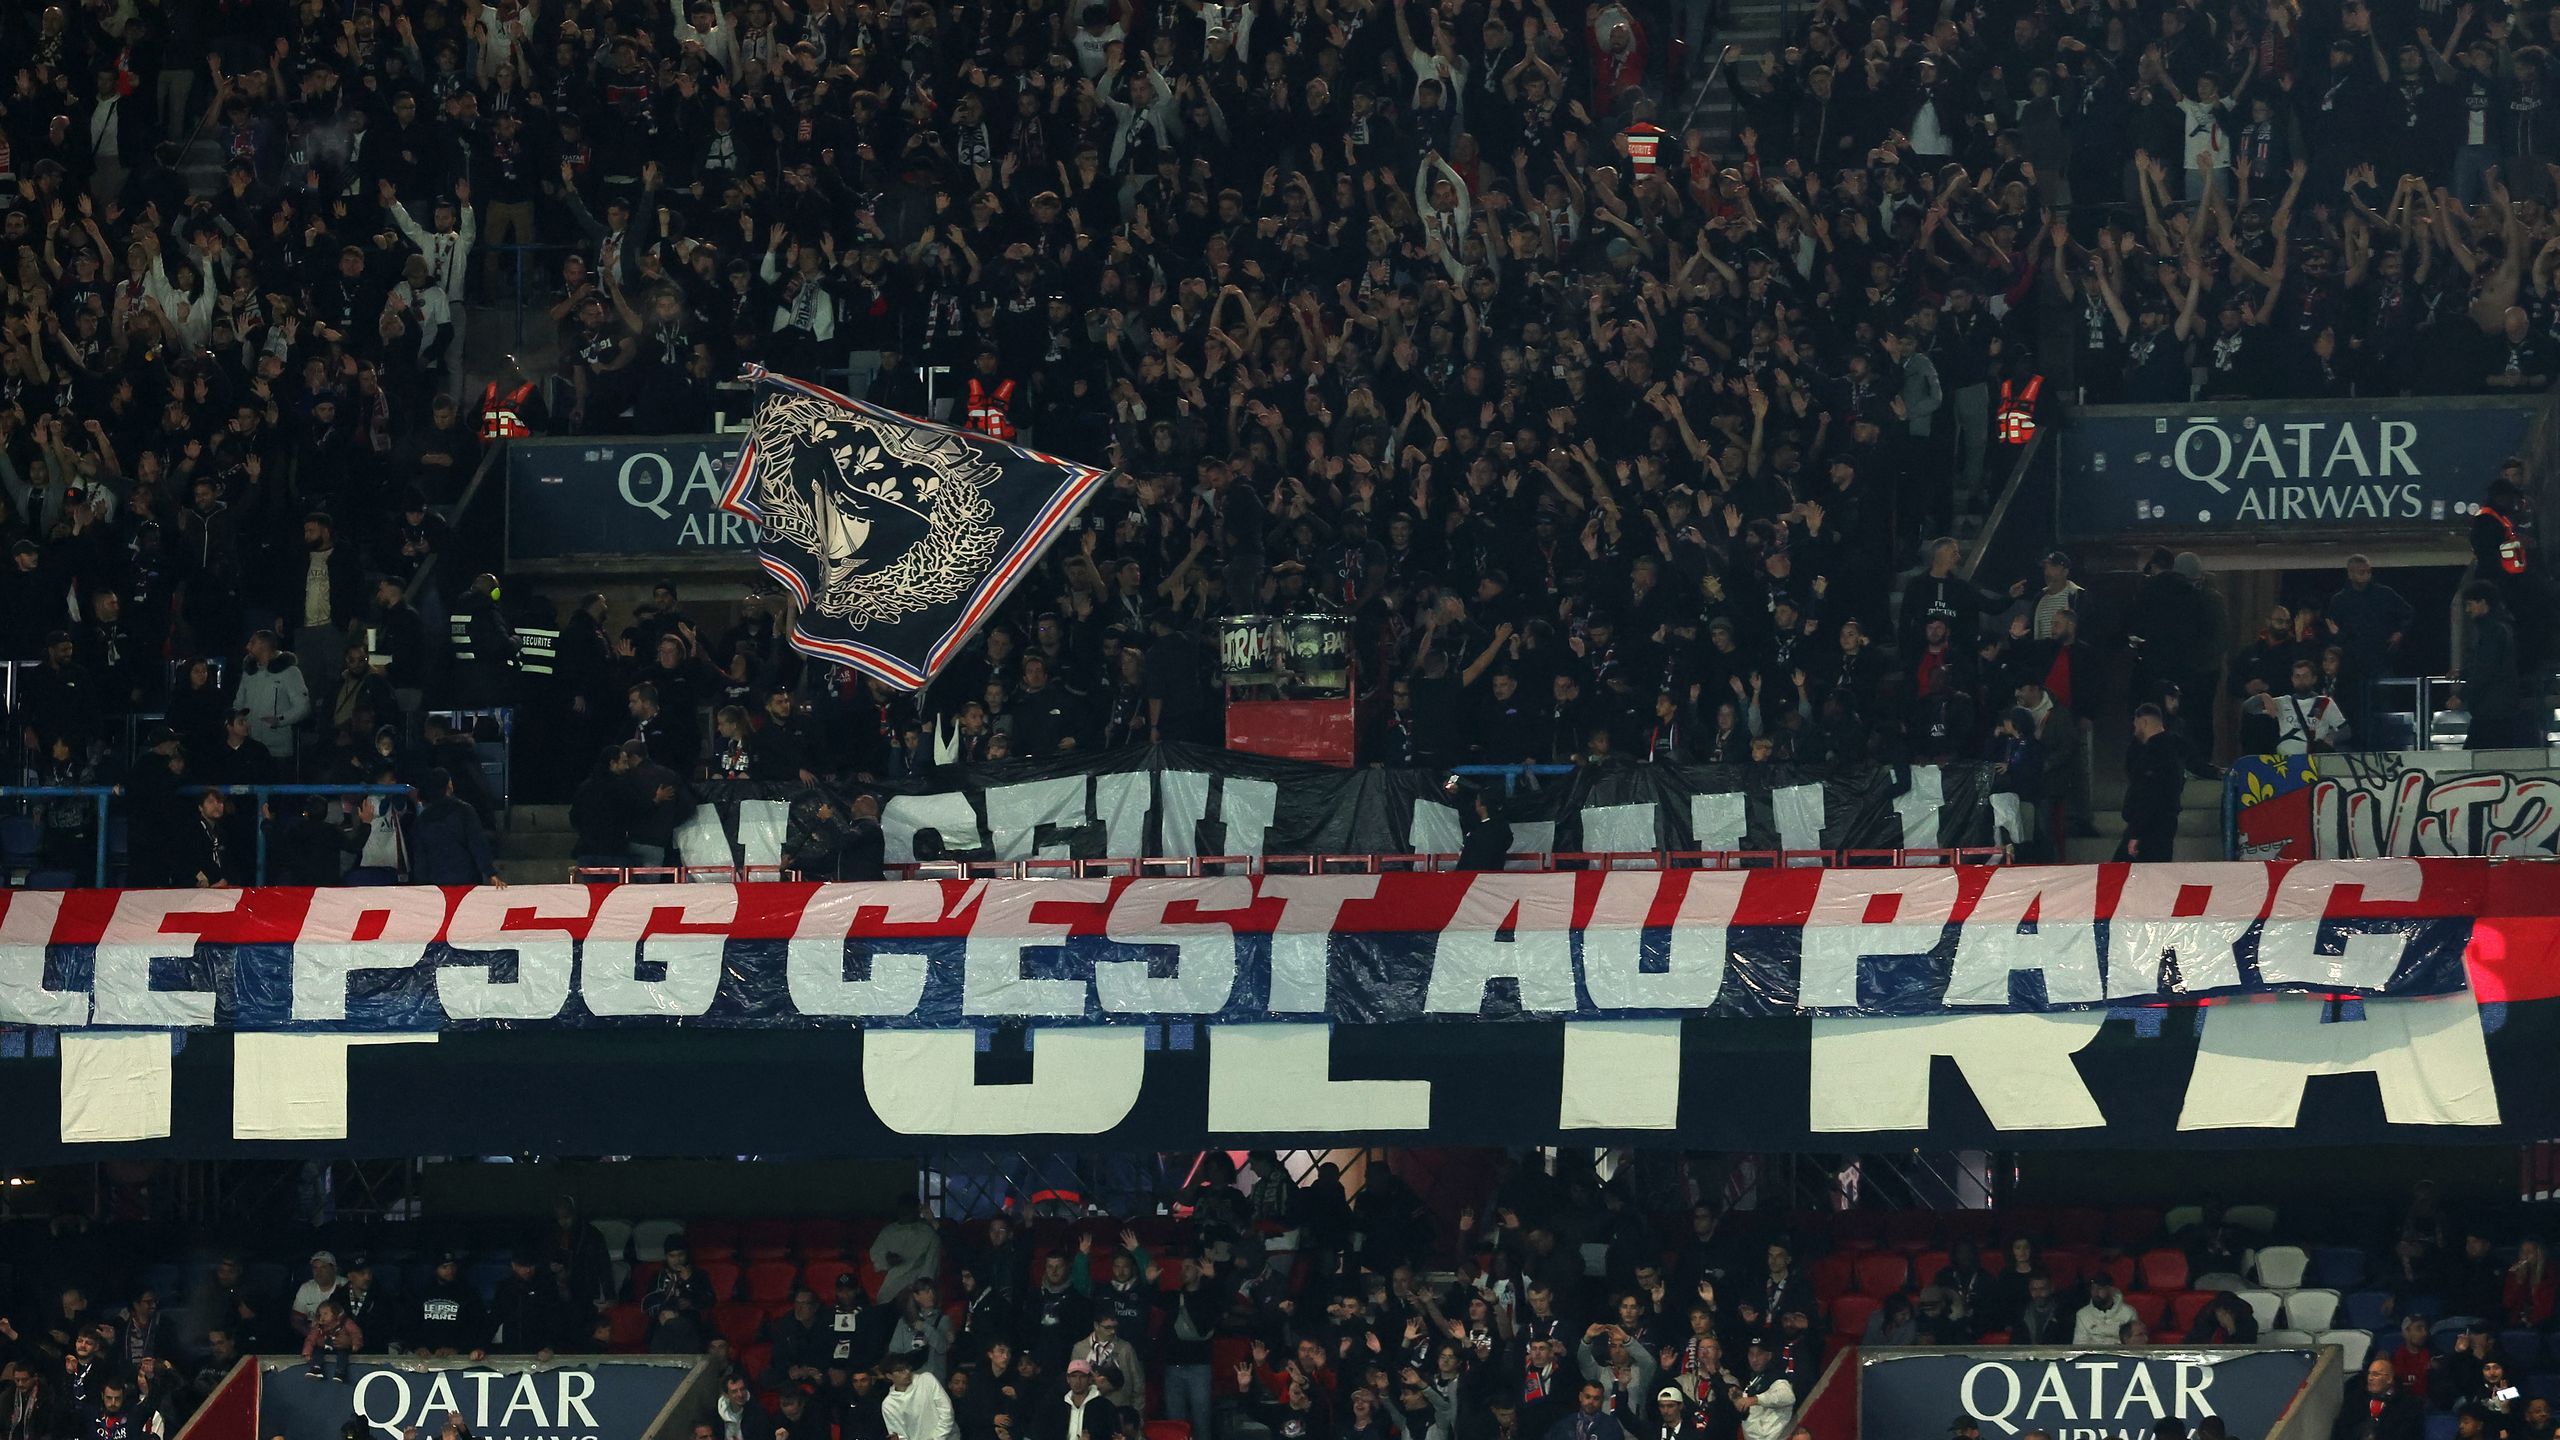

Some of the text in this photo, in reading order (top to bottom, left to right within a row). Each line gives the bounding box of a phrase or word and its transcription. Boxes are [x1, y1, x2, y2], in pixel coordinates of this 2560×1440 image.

[2510, 99, 2543, 111] Emirates
[2174, 421, 2421, 494] QATAR
[2236, 484, 2423, 520] AIRWAYS
[522, 635, 552, 648] SECURITE
[0, 857, 2424, 1027] LE PSG C'EST AU PARC
[424, 1313, 457, 1321] PARC
[438, 1304, 458, 1313] PSG
[353, 1370, 599, 1440] QATAR
[1960, 1361, 2218, 1436] QATAR
